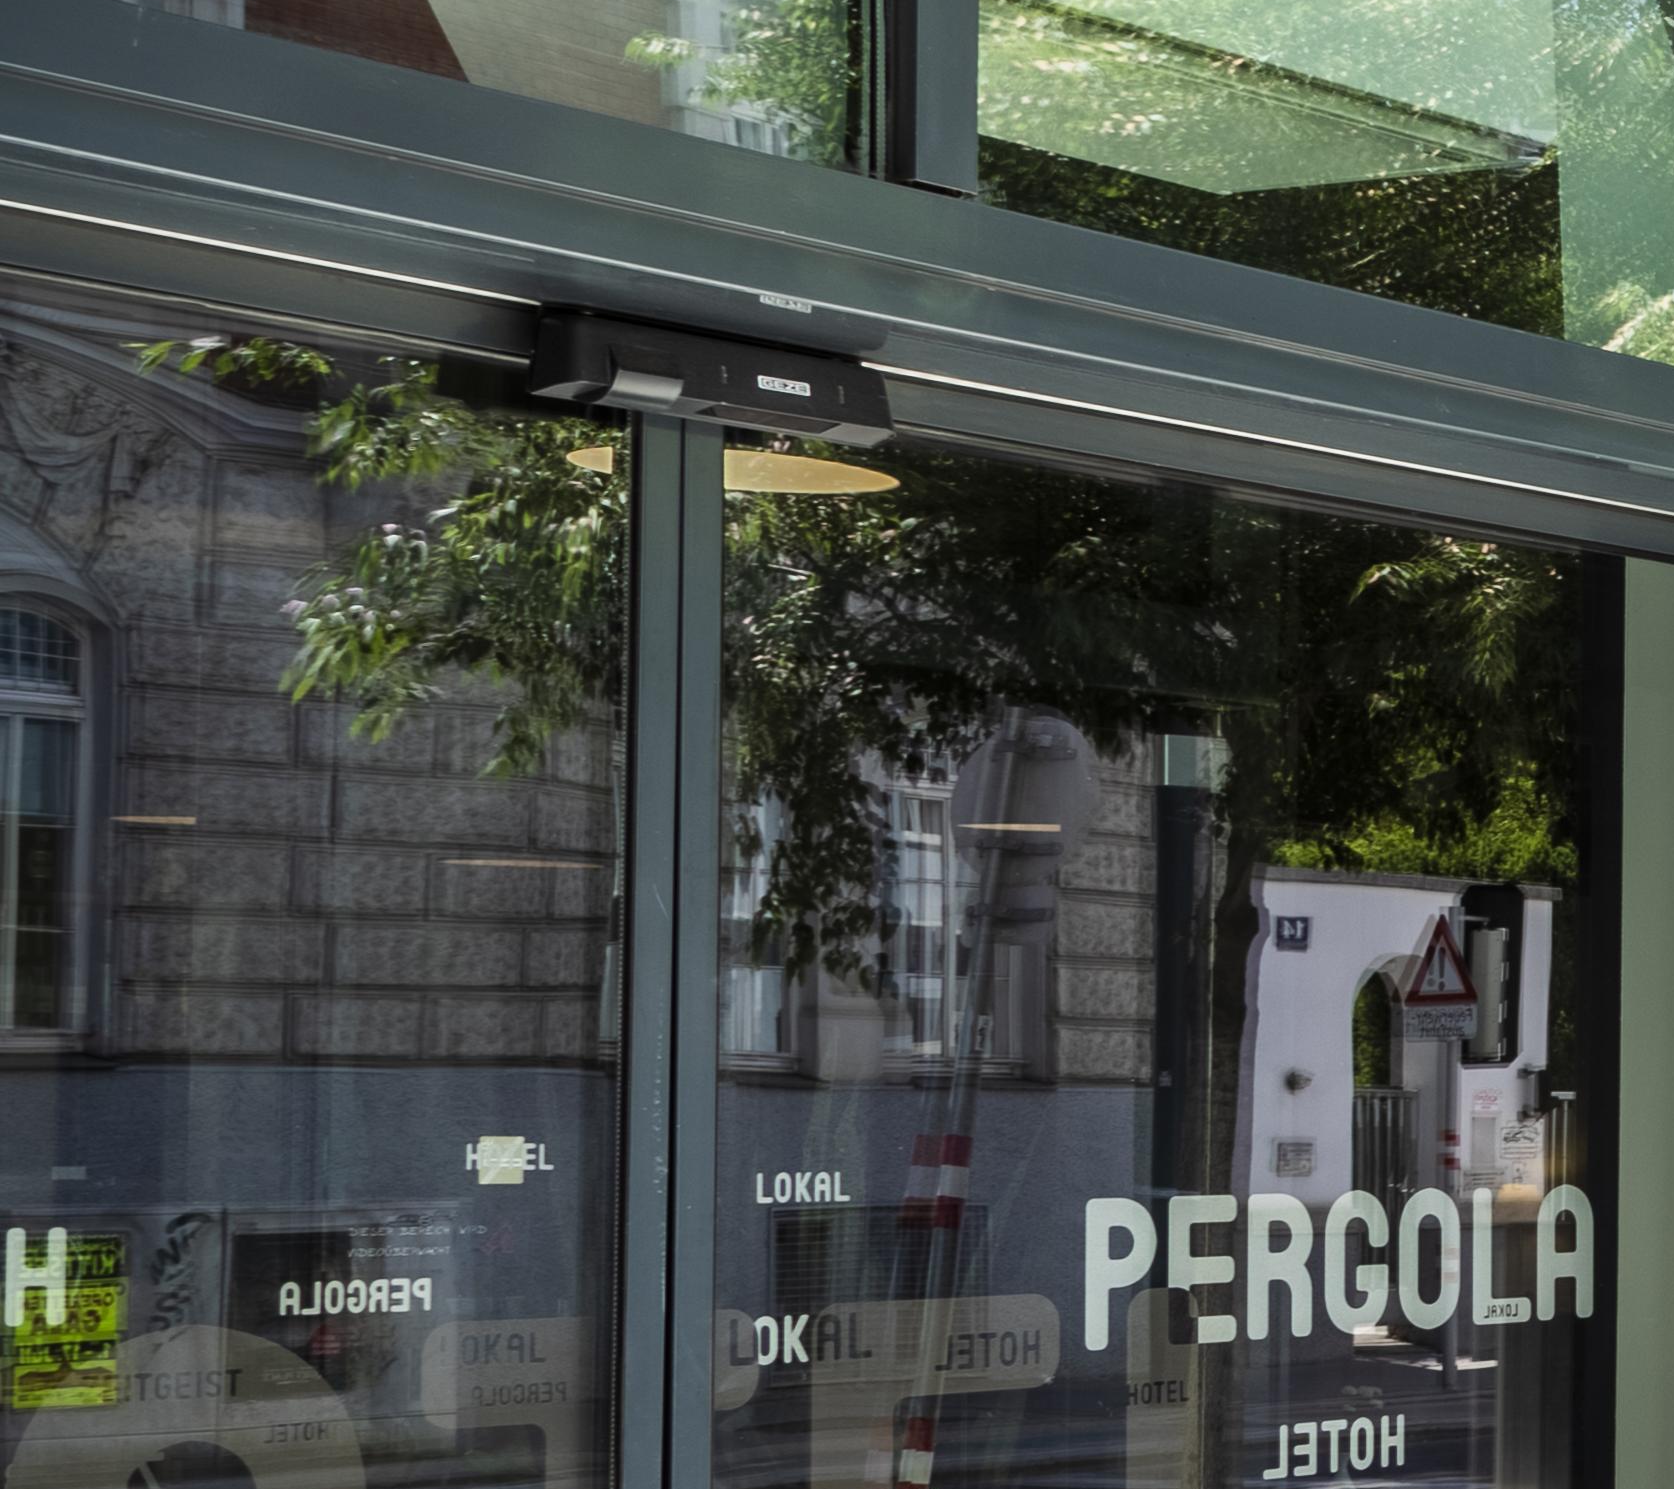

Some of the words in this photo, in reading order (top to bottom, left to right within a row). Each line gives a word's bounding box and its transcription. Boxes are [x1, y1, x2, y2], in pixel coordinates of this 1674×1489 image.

[762, 378, 808, 394] GEZE
[756, 1172, 851, 1204] LOKAL
[1084, 1184, 1595, 1351] PERGOLA
[729, 1313, 873, 1367] LOKAL
[1125, 1379, 1190, 1406] HOTEL
